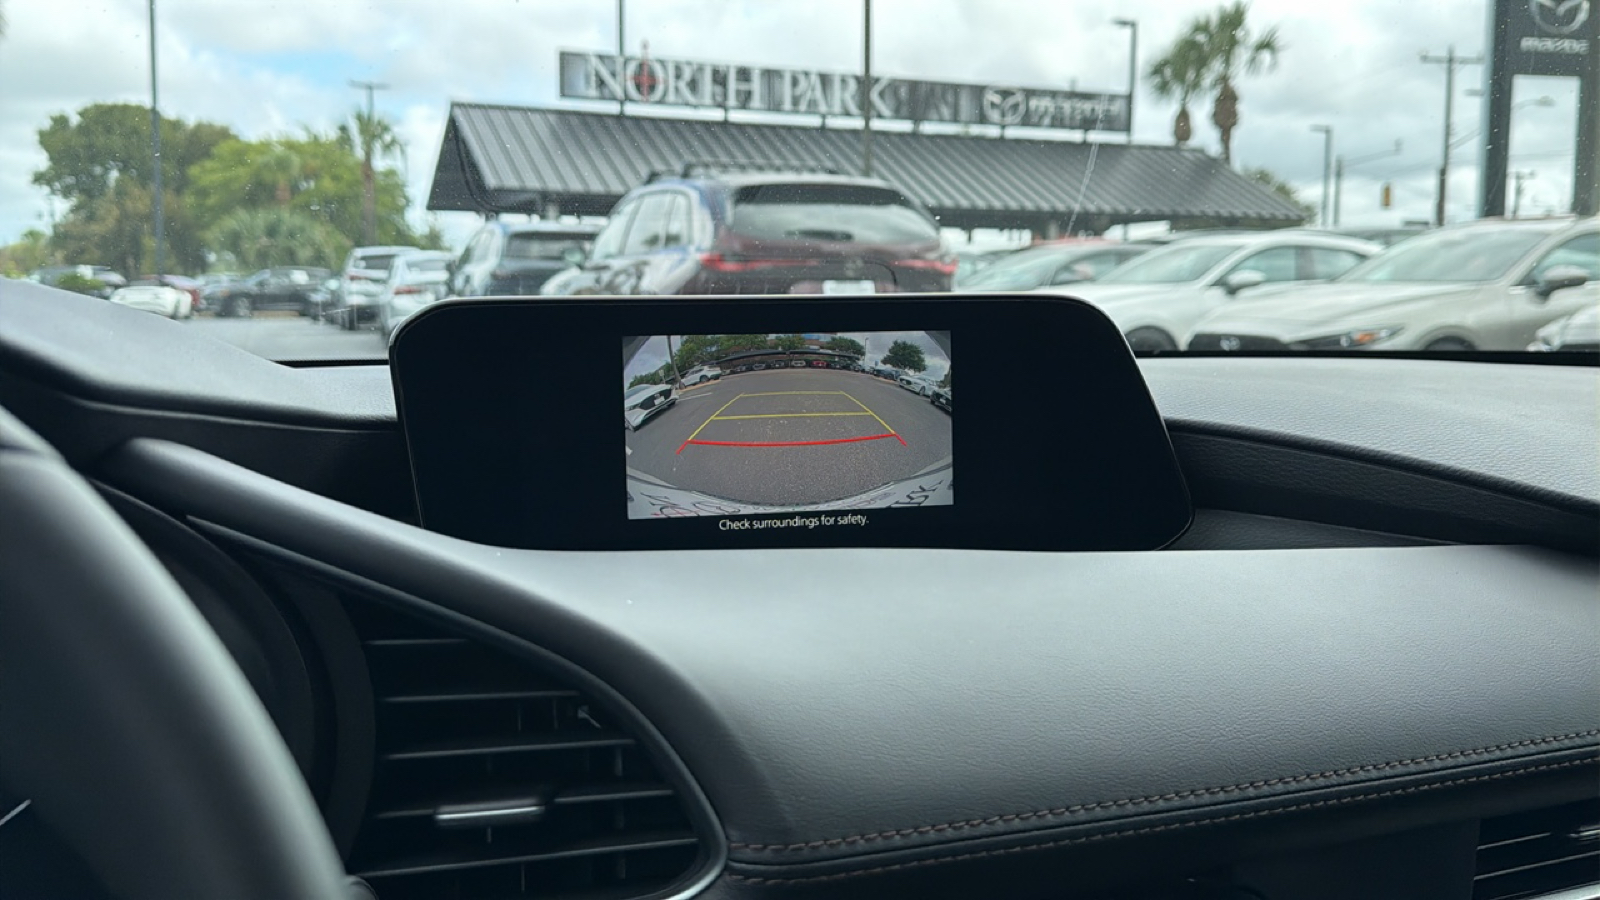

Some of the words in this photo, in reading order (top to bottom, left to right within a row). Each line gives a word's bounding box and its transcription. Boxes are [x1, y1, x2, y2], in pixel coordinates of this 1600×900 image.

[586, 53, 762, 110] NORTH
[780, 69, 893, 117] PARK
[719, 519, 750, 530] Check
[753, 516, 819, 529] surroundings
[821, 514, 835, 525] for
[837, 513, 869, 526] safety.
